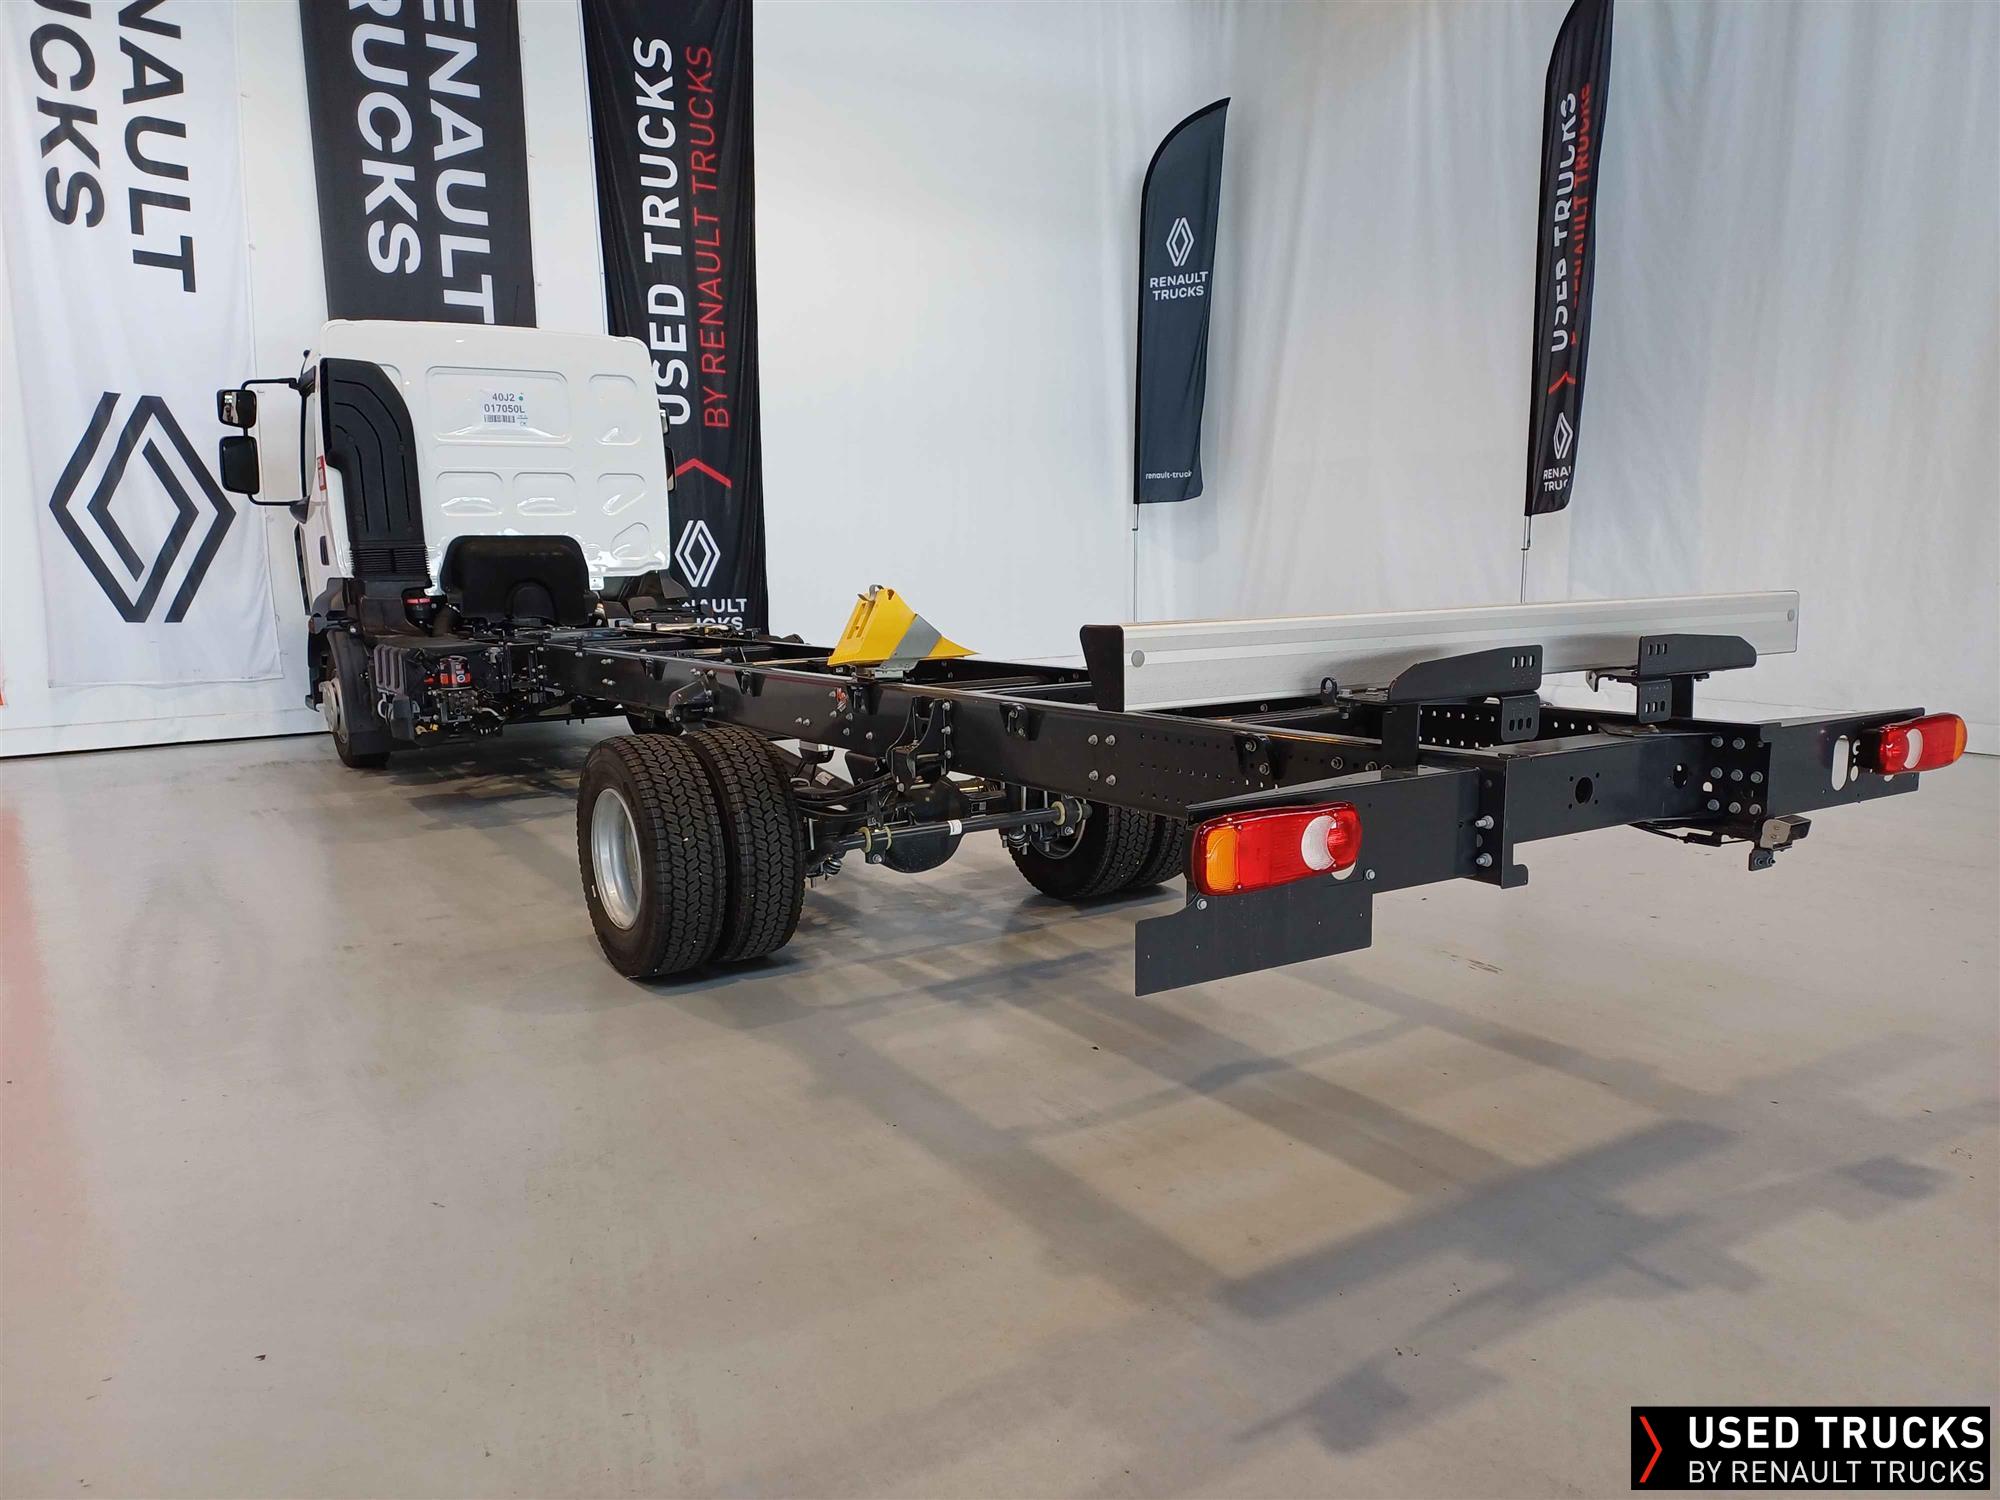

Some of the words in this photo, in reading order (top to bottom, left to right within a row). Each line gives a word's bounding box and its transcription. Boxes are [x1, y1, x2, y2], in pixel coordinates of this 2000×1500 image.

[686, 46, 718, 195] TRUCKS
[633, 36, 682, 263] TRUCKS
[694, 207, 726, 374] RENAULT
[1149, 271, 1209, 288] RENAULT
[1152, 285, 1205, 301] TRUCKS
[647, 283, 691, 425] USED
[484, 404, 525, 413] 017050L
[492, 393, 515, 401] 40J2
[703, 386, 730, 428] BY
